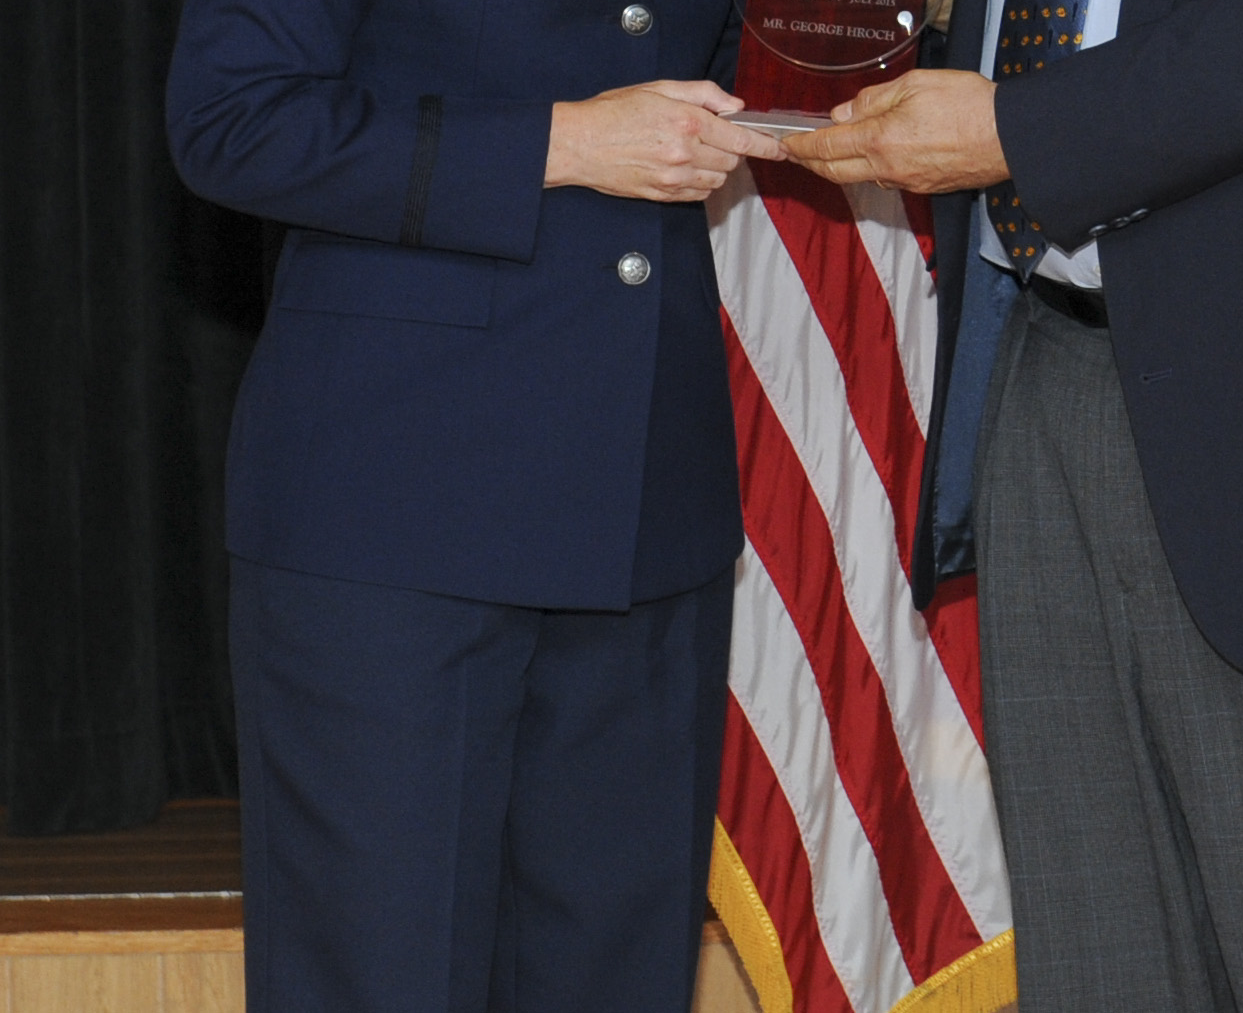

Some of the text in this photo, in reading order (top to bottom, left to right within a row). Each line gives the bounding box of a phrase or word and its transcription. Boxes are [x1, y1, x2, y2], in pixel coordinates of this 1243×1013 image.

[763, 17, 895, 42] MR. GEORGE HROCH
